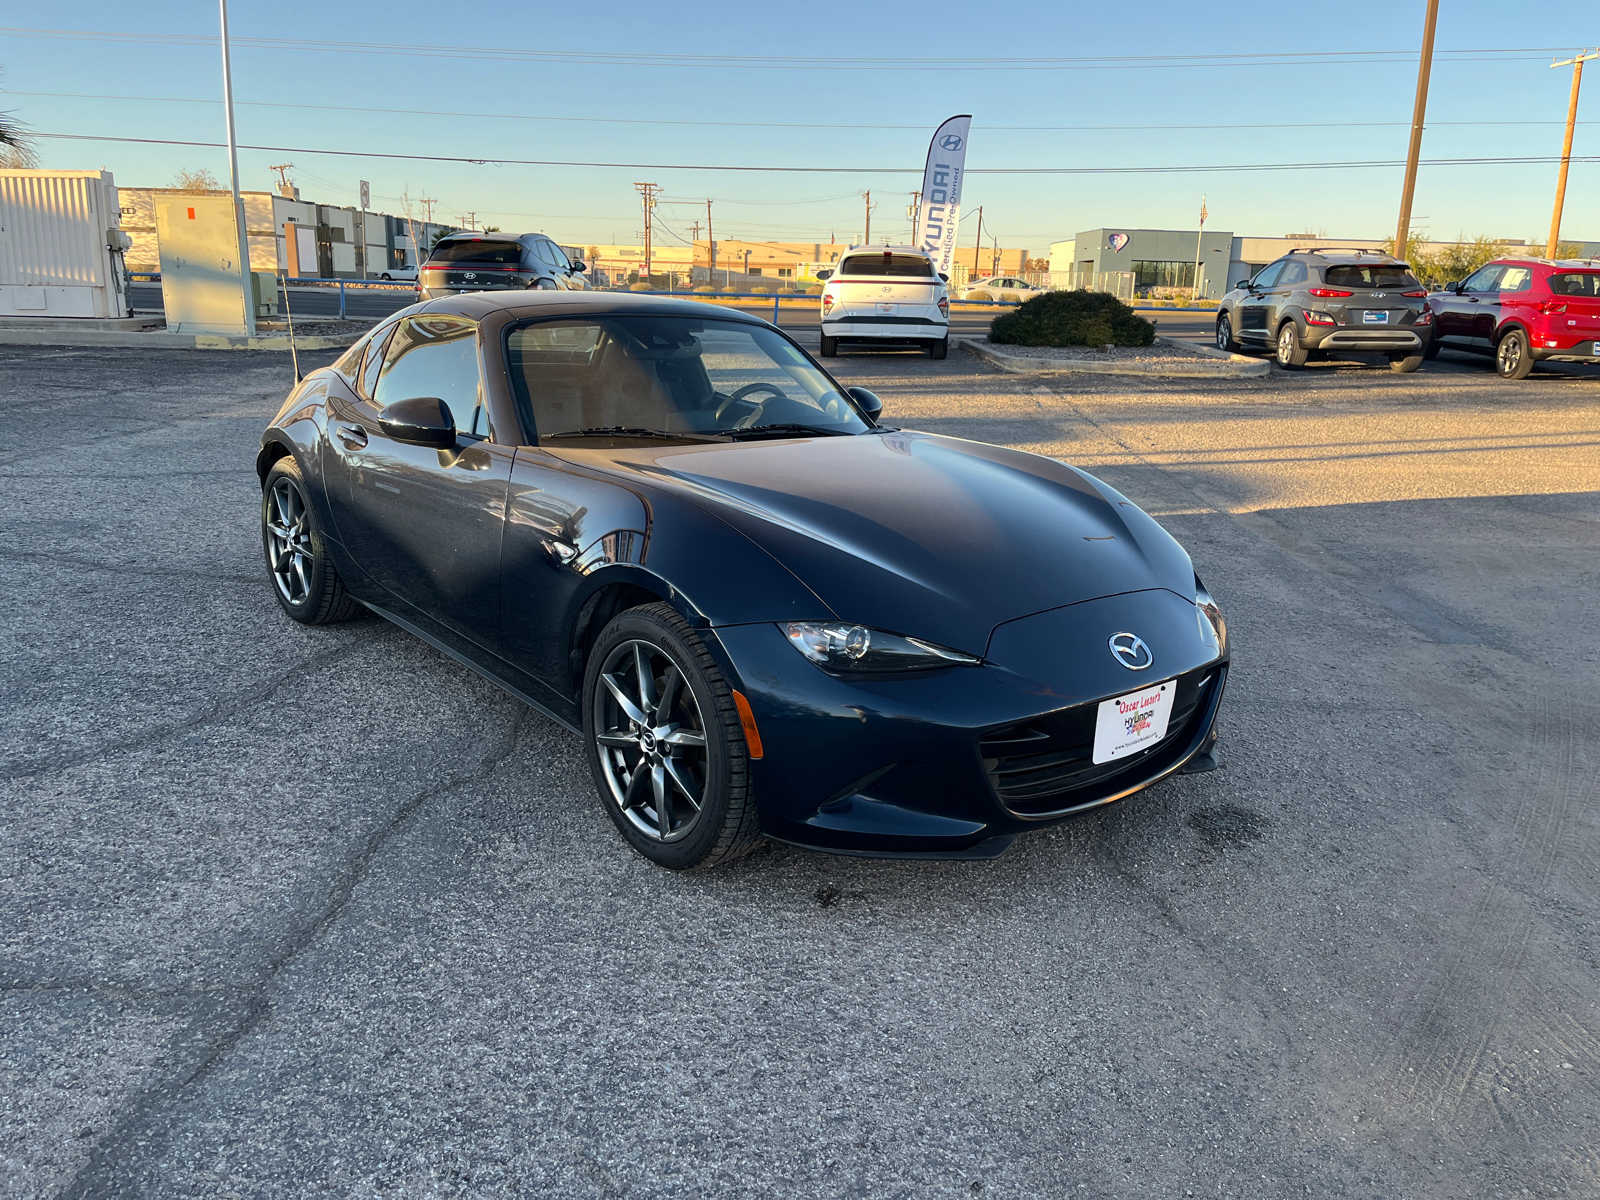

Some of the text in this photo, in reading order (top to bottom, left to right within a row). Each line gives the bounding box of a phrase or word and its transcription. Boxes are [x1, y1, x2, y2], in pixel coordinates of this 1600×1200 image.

[941, 168, 960, 271] Certified Pre-Owned
[661, 636, 691, 673] Continental
[1119, 701, 1140, 714] Oscar
[1124, 710, 1154, 726] HYUNDAI
